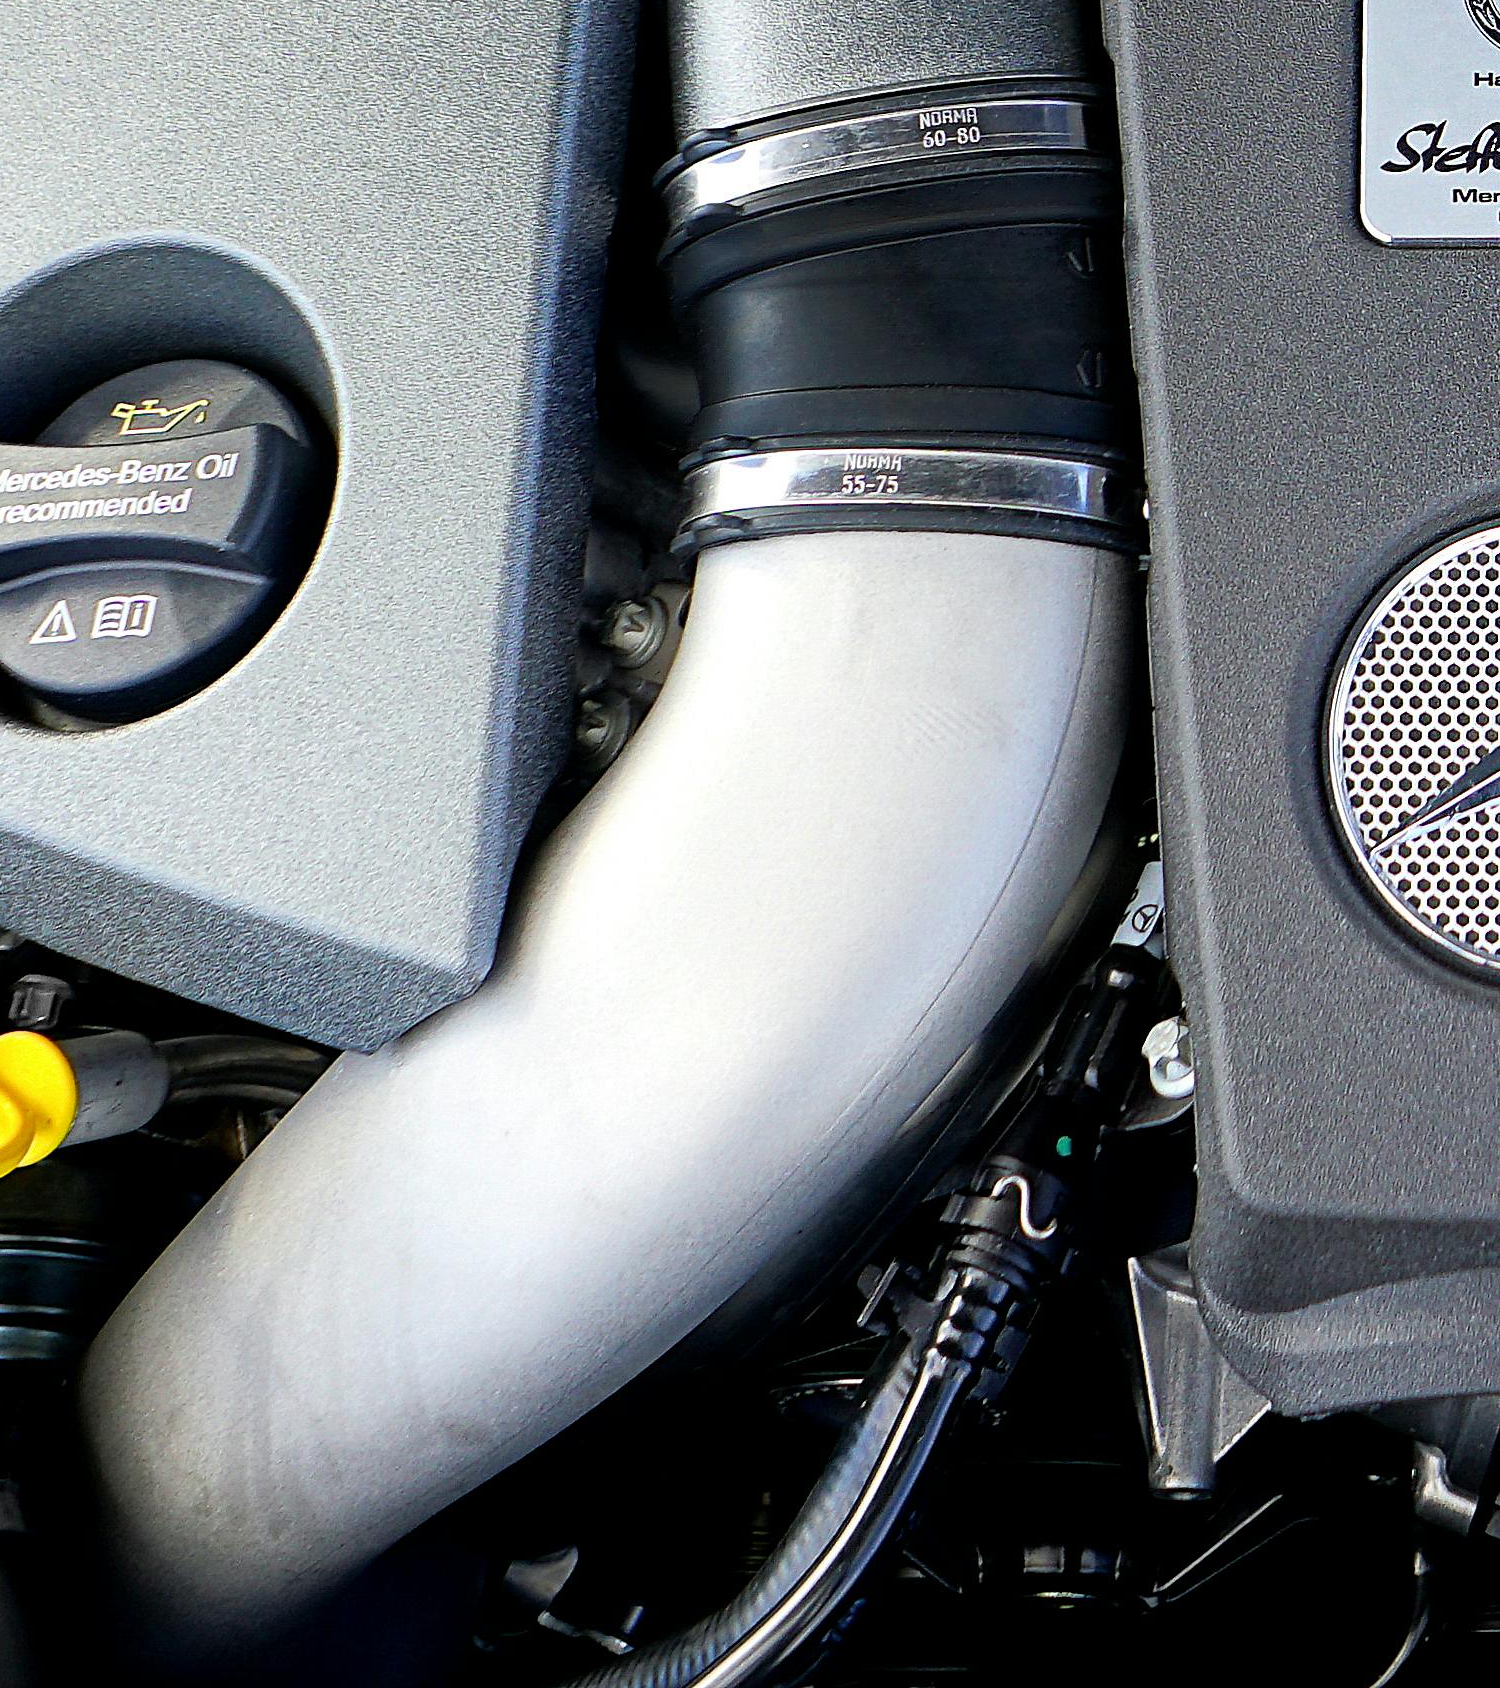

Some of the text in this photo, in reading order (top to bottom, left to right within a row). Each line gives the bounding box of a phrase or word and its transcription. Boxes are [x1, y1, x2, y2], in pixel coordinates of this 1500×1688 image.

[918, 107, 979, 129] NORMA
[922, 127, 981, 148] 60-80
[195, 451, 240, 480] Oil
[840, 474, 900, 495] 55-75
